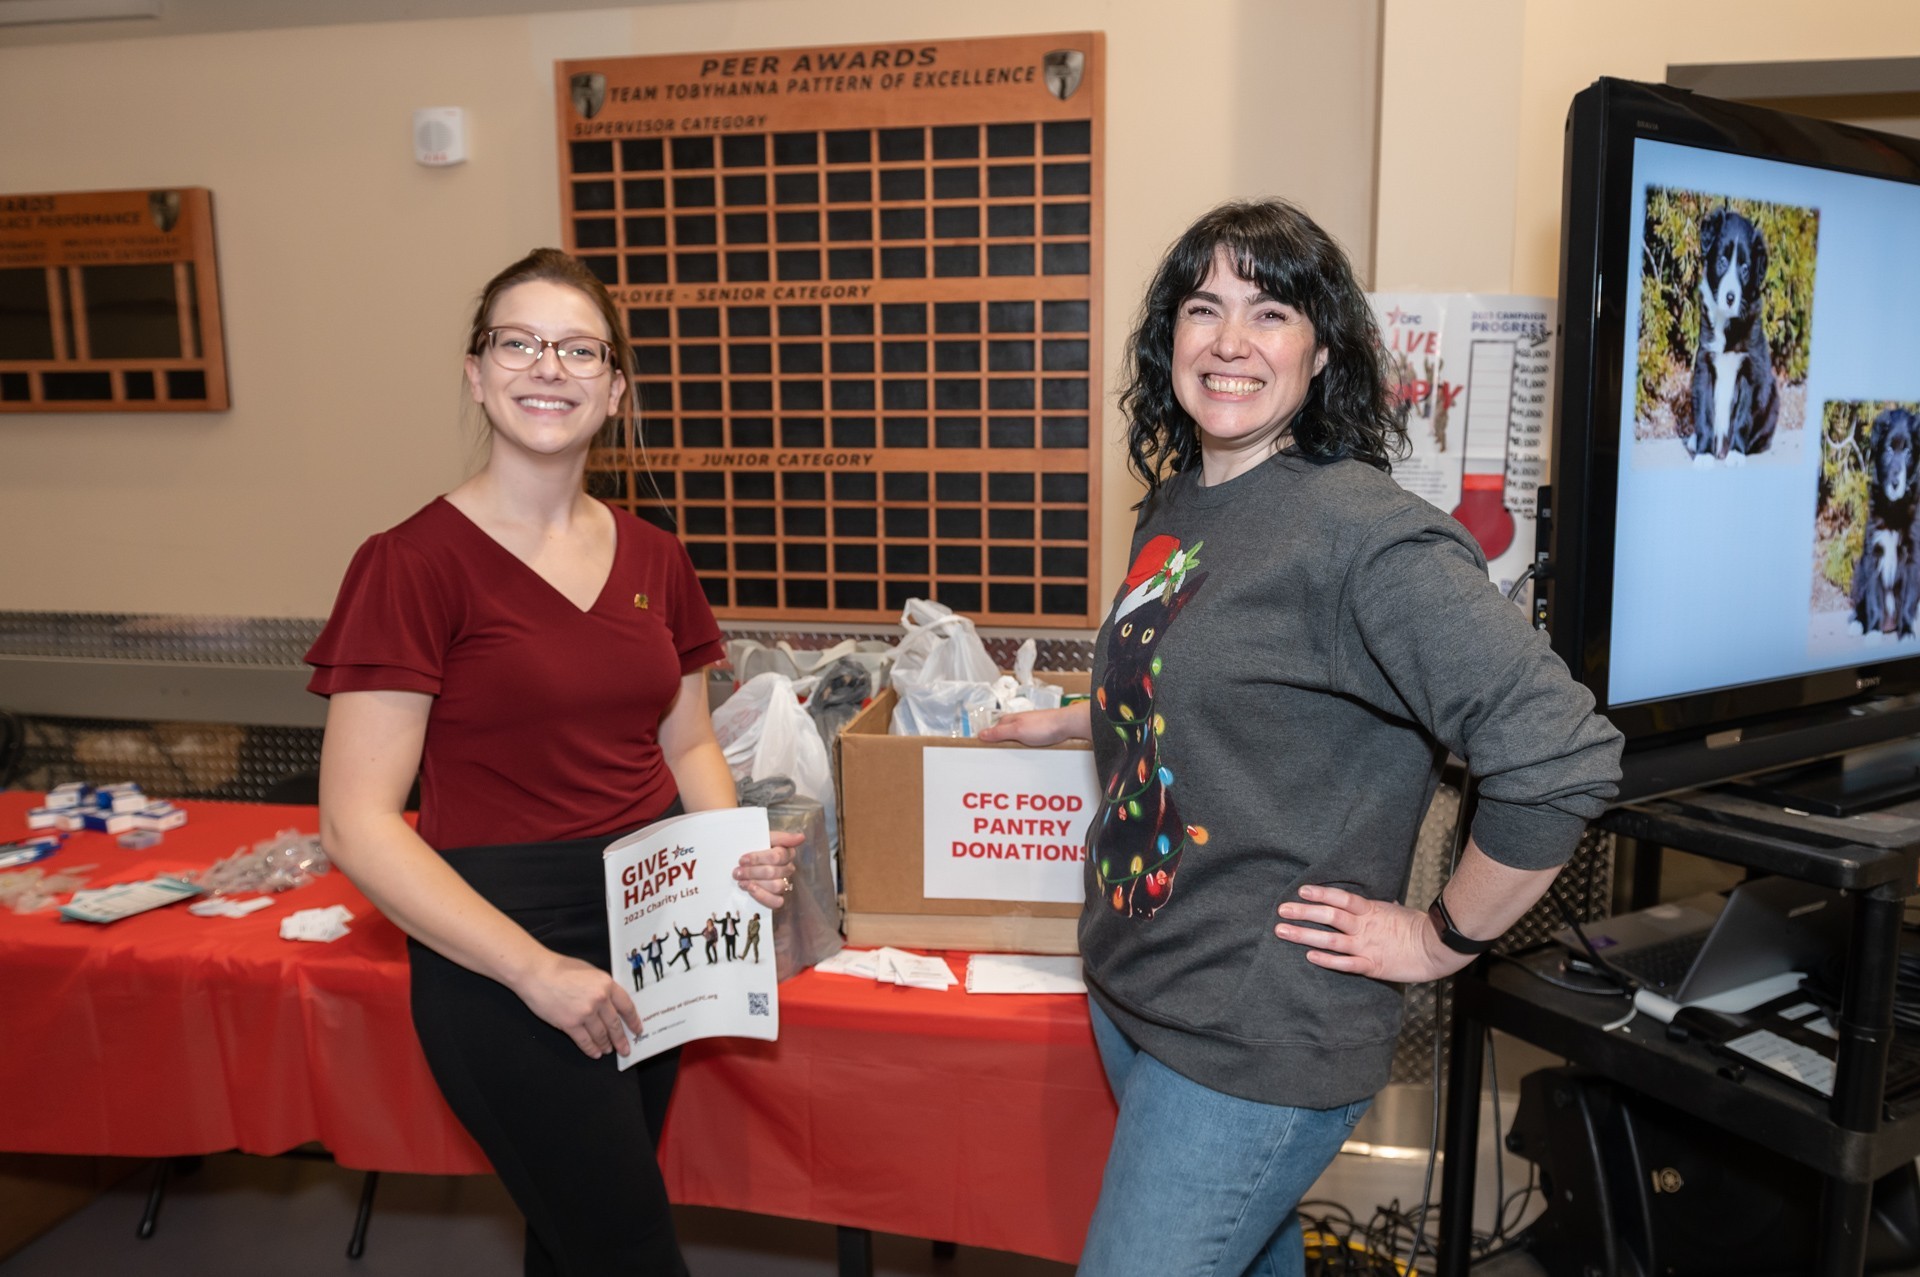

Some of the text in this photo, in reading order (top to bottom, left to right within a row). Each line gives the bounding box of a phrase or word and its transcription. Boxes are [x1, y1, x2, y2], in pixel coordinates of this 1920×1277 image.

[700, 47, 938, 76] PEER AWARDS
[609, 65, 1036, 102] TEAM TOBYHANNA PATTERN OF EXCELLENCE
[574, 114, 767, 136] SUPERVISOR CATEGORY
[607, 289, 675, 303] PLOYEE
[697, 287, 767, 301] SENIOR
[773, 285, 872, 299] CATEGORY
[1471, 321, 1547, 333] PROGRESS
[701, 454, 769, 466] JUNIOR
[777, 454, 873, 466] CATEGORY
[1856, 676, 1880, 689] SONY
[962, 792, 1083, 812] CFC FOOD
[974, 817, 1071, 837] PANTRY
[621, 846, 695, 887] GIVE CFC
[624, 858, 697, 910] HAPPY
[623, 886, 699, 926] 2023 Charity List
